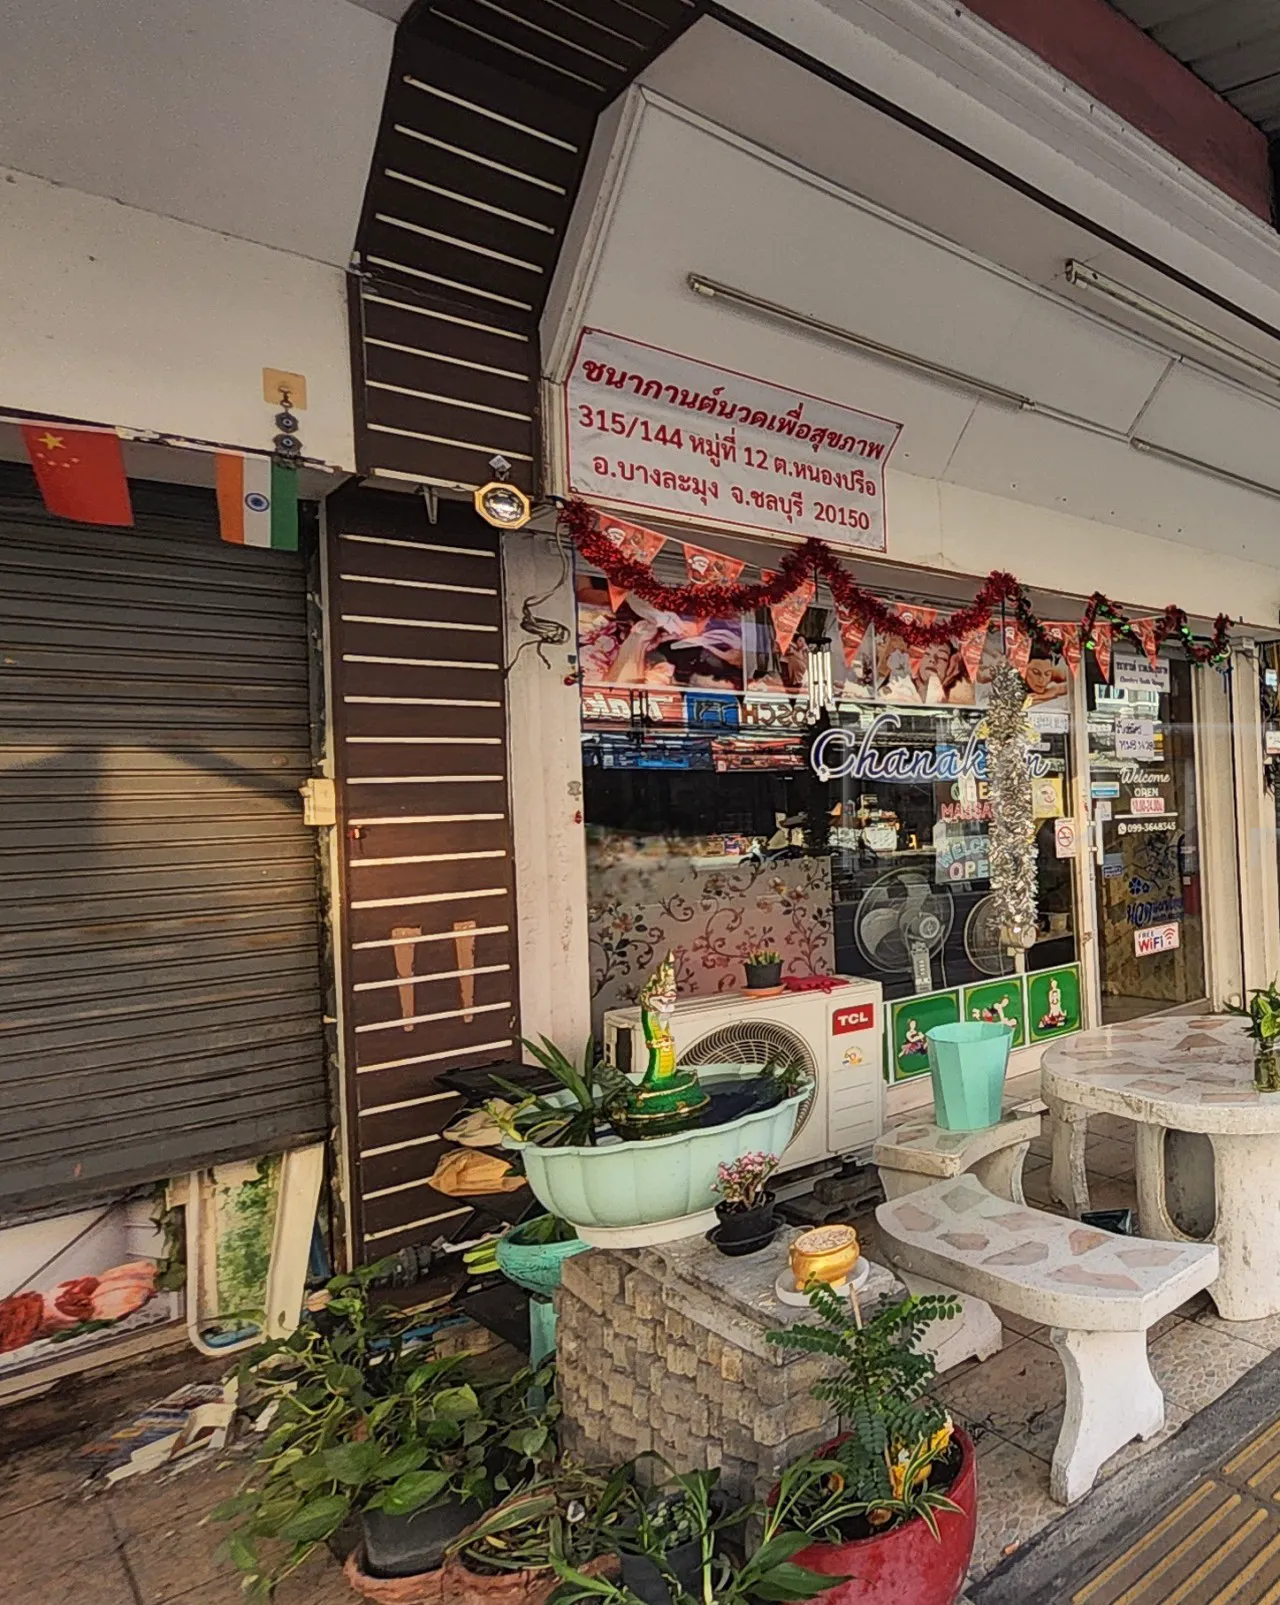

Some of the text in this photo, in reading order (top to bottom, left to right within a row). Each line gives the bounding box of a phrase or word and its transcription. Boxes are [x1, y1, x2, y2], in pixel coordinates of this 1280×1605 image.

[582, 360, 884, 458] ชนากานต์นวดเพื่อสุขภาพ
[578, 403, 877, 497] 315/144 หมู่ที่ 12 ต.หนองปรือ
[592, 454, 871, 531] อ.บางละมุง จ.ชลบุรี 20150
[810, 712, 1050, 782] Chanakn
[1119, 766, 1171, 785] Welcome
[1138, 937, 1164, 953] WiFi
[838, 1012, 868, 1026] TCL
